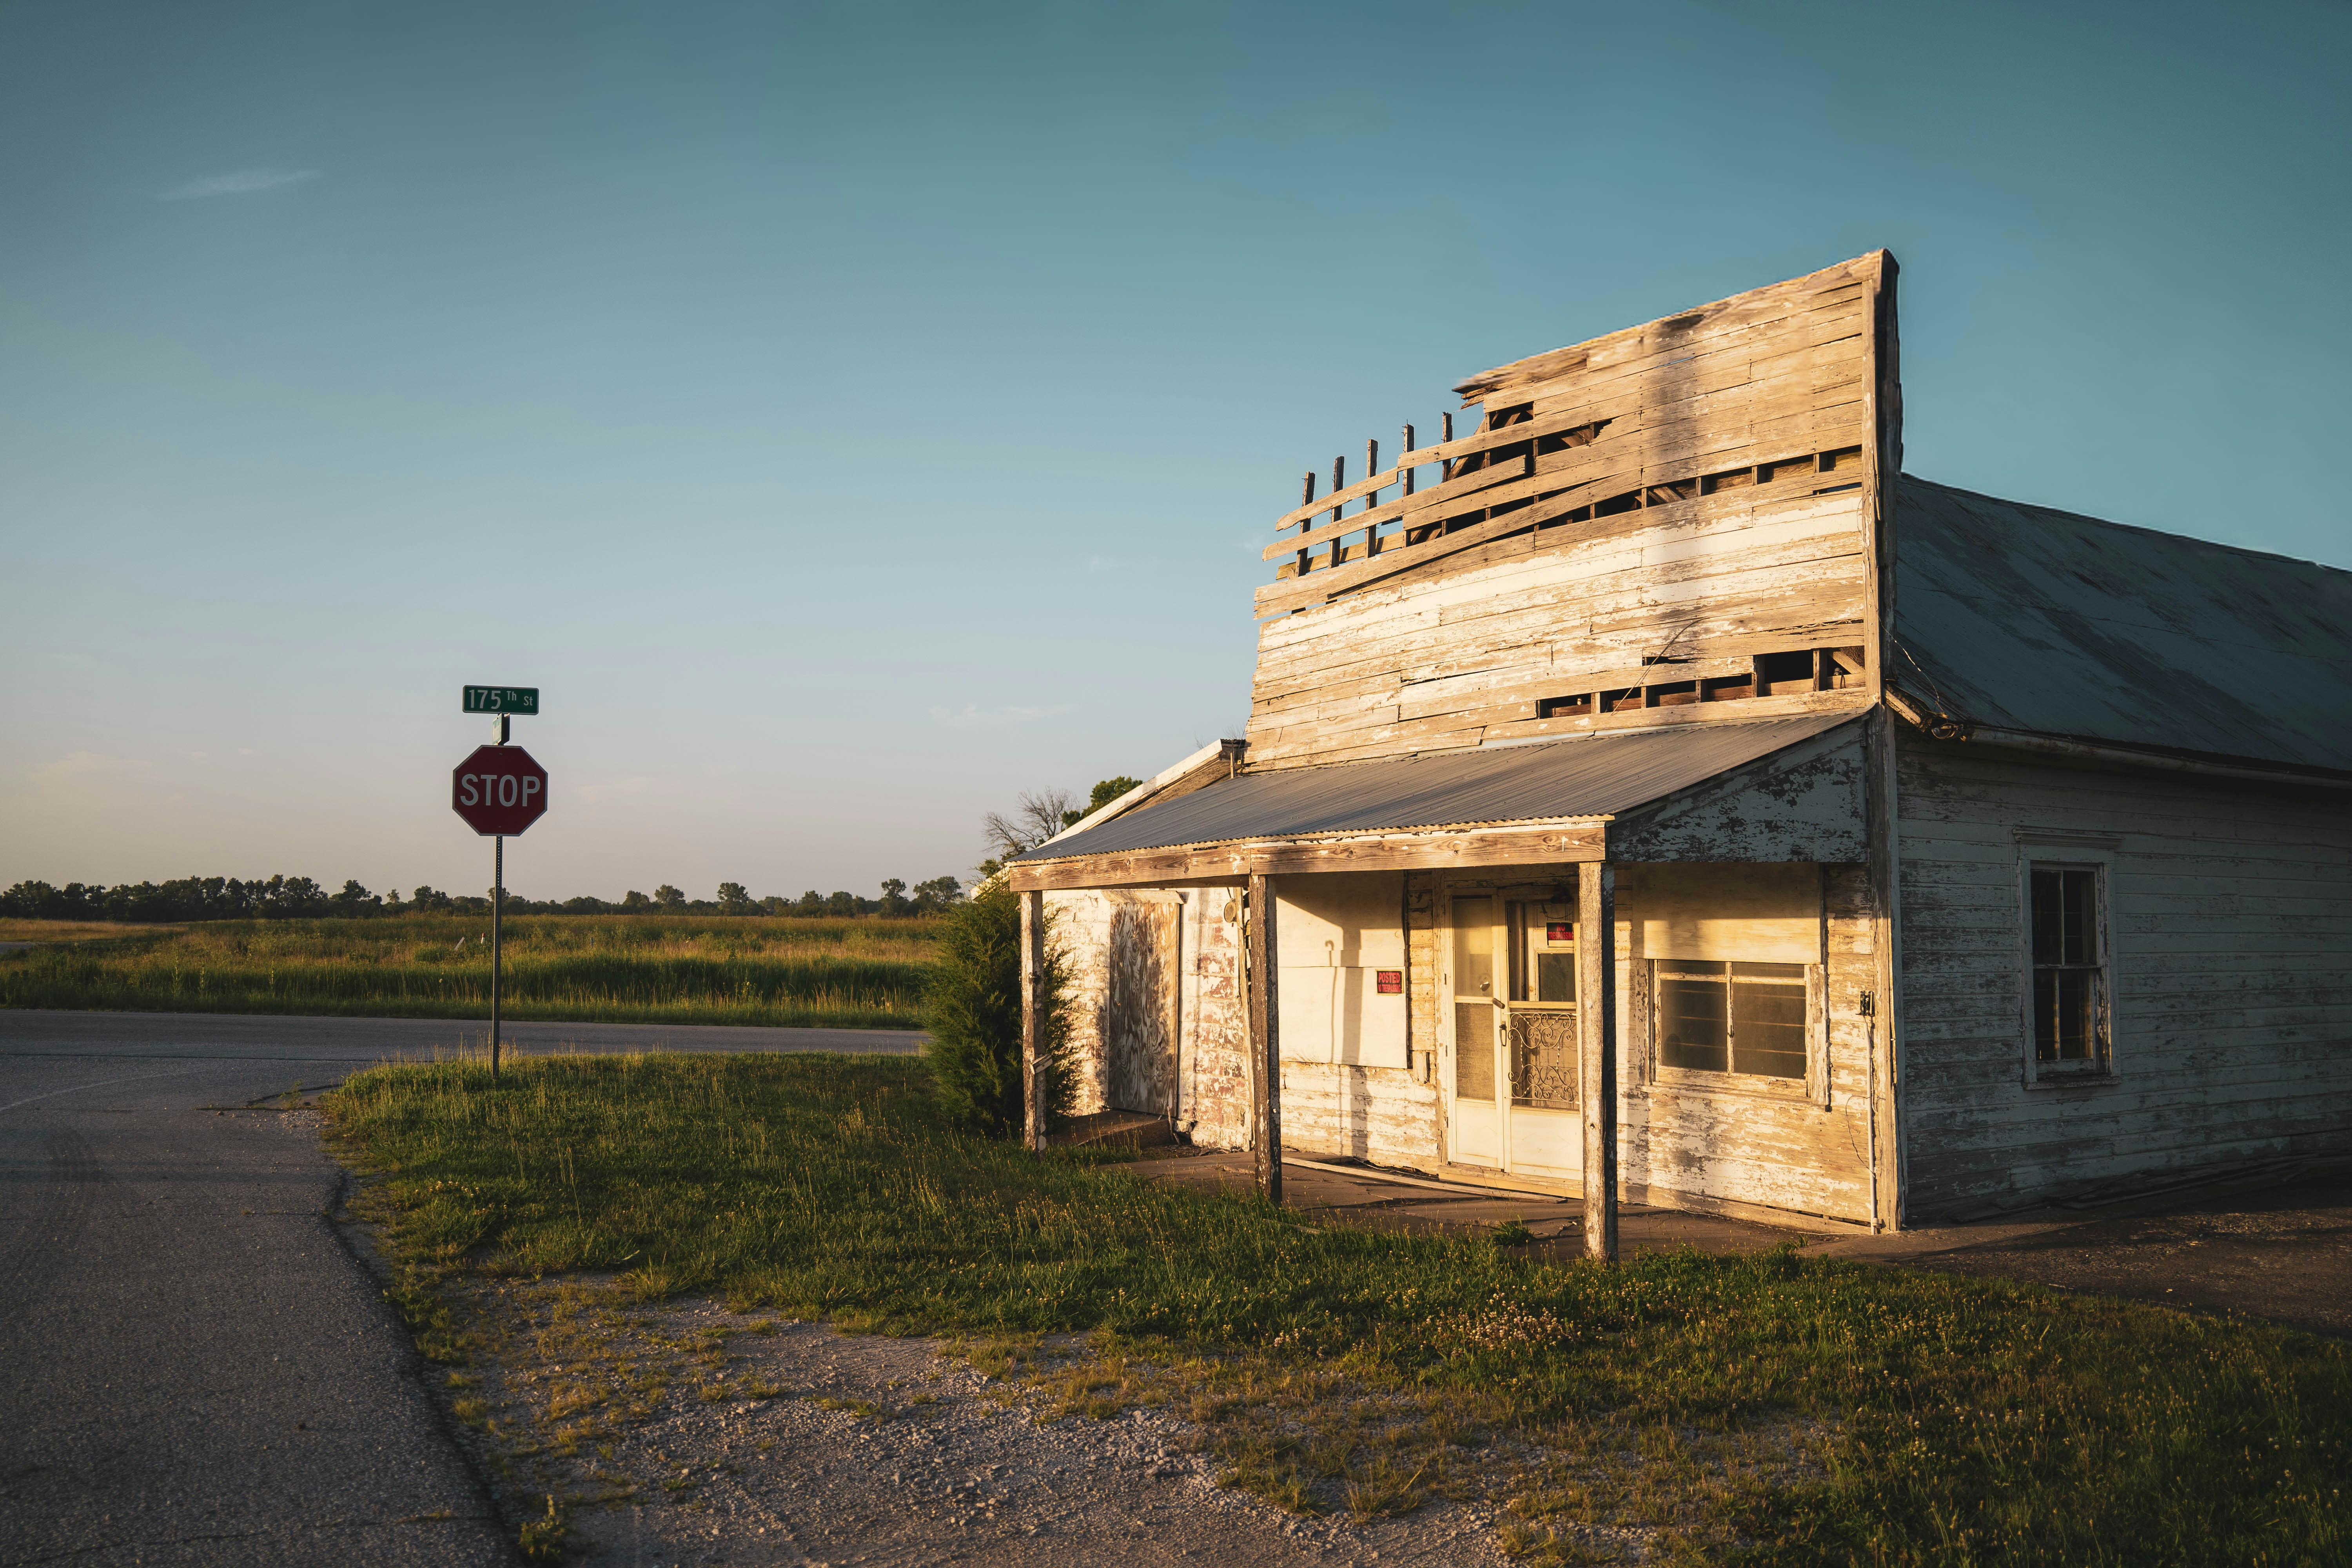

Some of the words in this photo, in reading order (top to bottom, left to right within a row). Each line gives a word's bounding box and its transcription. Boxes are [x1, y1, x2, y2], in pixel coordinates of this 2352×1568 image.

[469, 690, 501, 709] 175
[506, 691, 516, 701] Th
[523, 696, 533, 706] St
[460, 774, 541, 807] STOP
[1379, 972, 1400, 983] POSTED
[1378, 984, 1381, 992] NO
[1382, 984, 1401, 993] TRESPASSING
